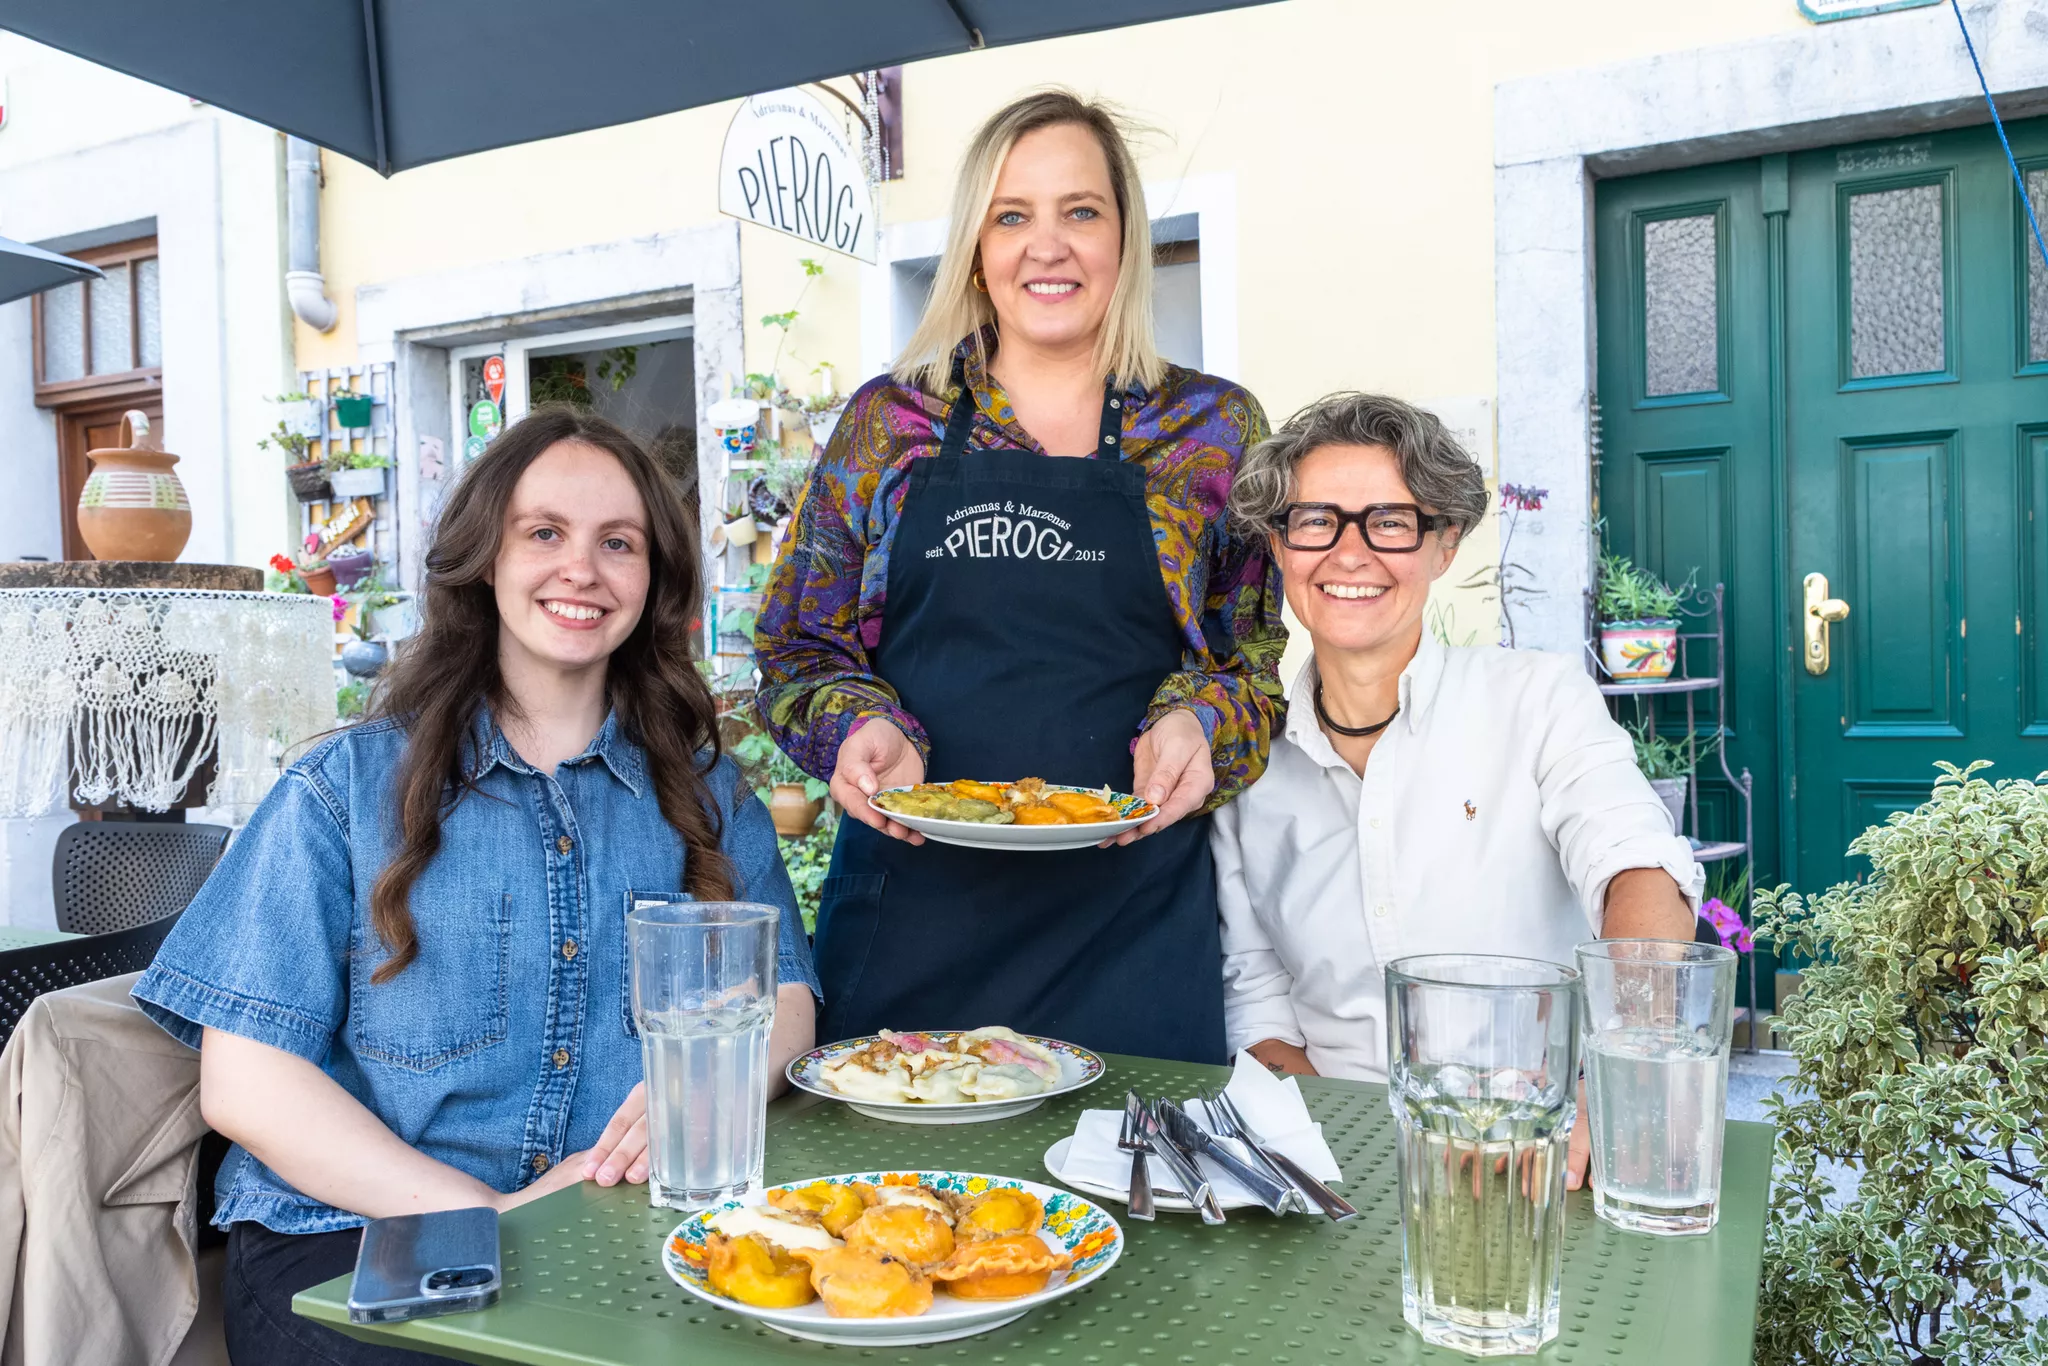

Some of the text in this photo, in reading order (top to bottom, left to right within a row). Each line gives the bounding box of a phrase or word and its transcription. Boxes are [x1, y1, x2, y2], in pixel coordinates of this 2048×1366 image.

[738, 135, 863, 253] PIEROGI
[945, 500, 1072, 531] Adriannas & Marzenas
[925, 546, 944, 559] seit
[1075, 549, 1106, 562] 2015
